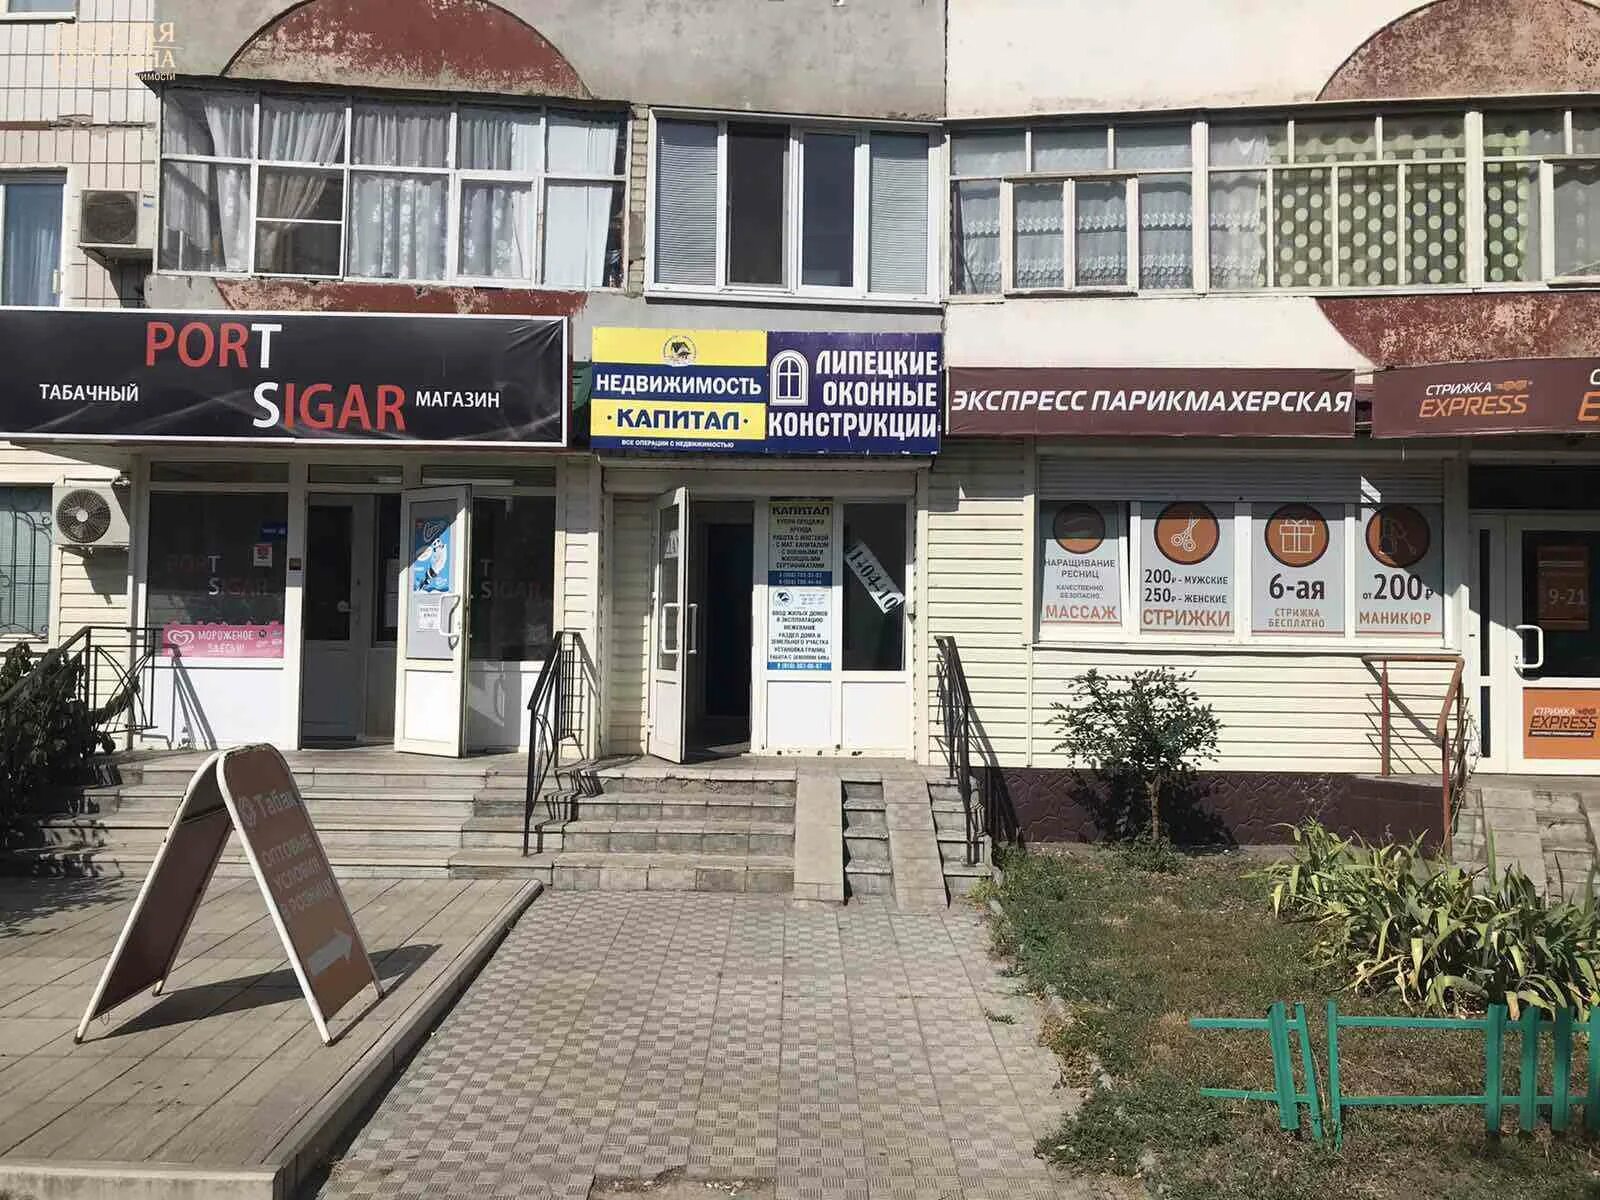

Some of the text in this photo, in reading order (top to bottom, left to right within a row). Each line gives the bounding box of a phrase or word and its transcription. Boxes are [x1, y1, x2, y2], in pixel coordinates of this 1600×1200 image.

[146, 321, 282, 369] PORT
[816, 350, 937, 379] ЛИПЕЦКИЕ
[596, 374, 762, 395] НЕДВИЖИМОСТЬ
[1426, 382, 1492, 396] СТРИЖКА
[39, 383, 139, 402] ТАБАЧНЫЙ
[415, 391, 500, 408] МАГАЗИН
[823, 381, 937, 407] ОКОННЫЕ
[252, 381, 407, 432] SIGAR
[951, 390, 1353, 413] ЭКСПРЕСС ПАРИКМАХЕРСКАЯ
[1419, 394, 1529, 418] EXPRESS
[617, 408, 740, 430] КАПИТАЛ
[768, 412, 937, 440] КОНСТРУКЦИИ
[635, 439, 670, 448] ОПЕРАЦИИ
[772, 506, 830, 516] КАПИТАЛ
[1045, 559, 1116, 569] НАРАЩИВАНИЕ
[1061, 570, 1099, 579] РЕСНИЦ
[1184, 576, 1229, 585] МУЖСКИЕ
[1056, 584, 1104, 592] КАЧЕСТВЕННО
[1269, 573, 1325, 600] 6-ая
[1184, 594, 1228, 604] ЖЕНСКИЕ
[1549, 588, 1586, 605] 9-21
[1046, 605, 1117, 619] МАССАЖ
[1143, 608, 1230, 627] СТРИЖКИ
[1274, 608, 1320, 617] СТРИЖКА
[1359, 611, 1431, 625] МАНИКЮР
[1268, 619, 1325, 628] БЕСПЛАТНО
[198, 630, 253, 641] МОРОЖЕНОЕ
[1534, 706, 1576, 716] СТРИЖКА
[1530, 715, 1599, 729] EXPRESS
